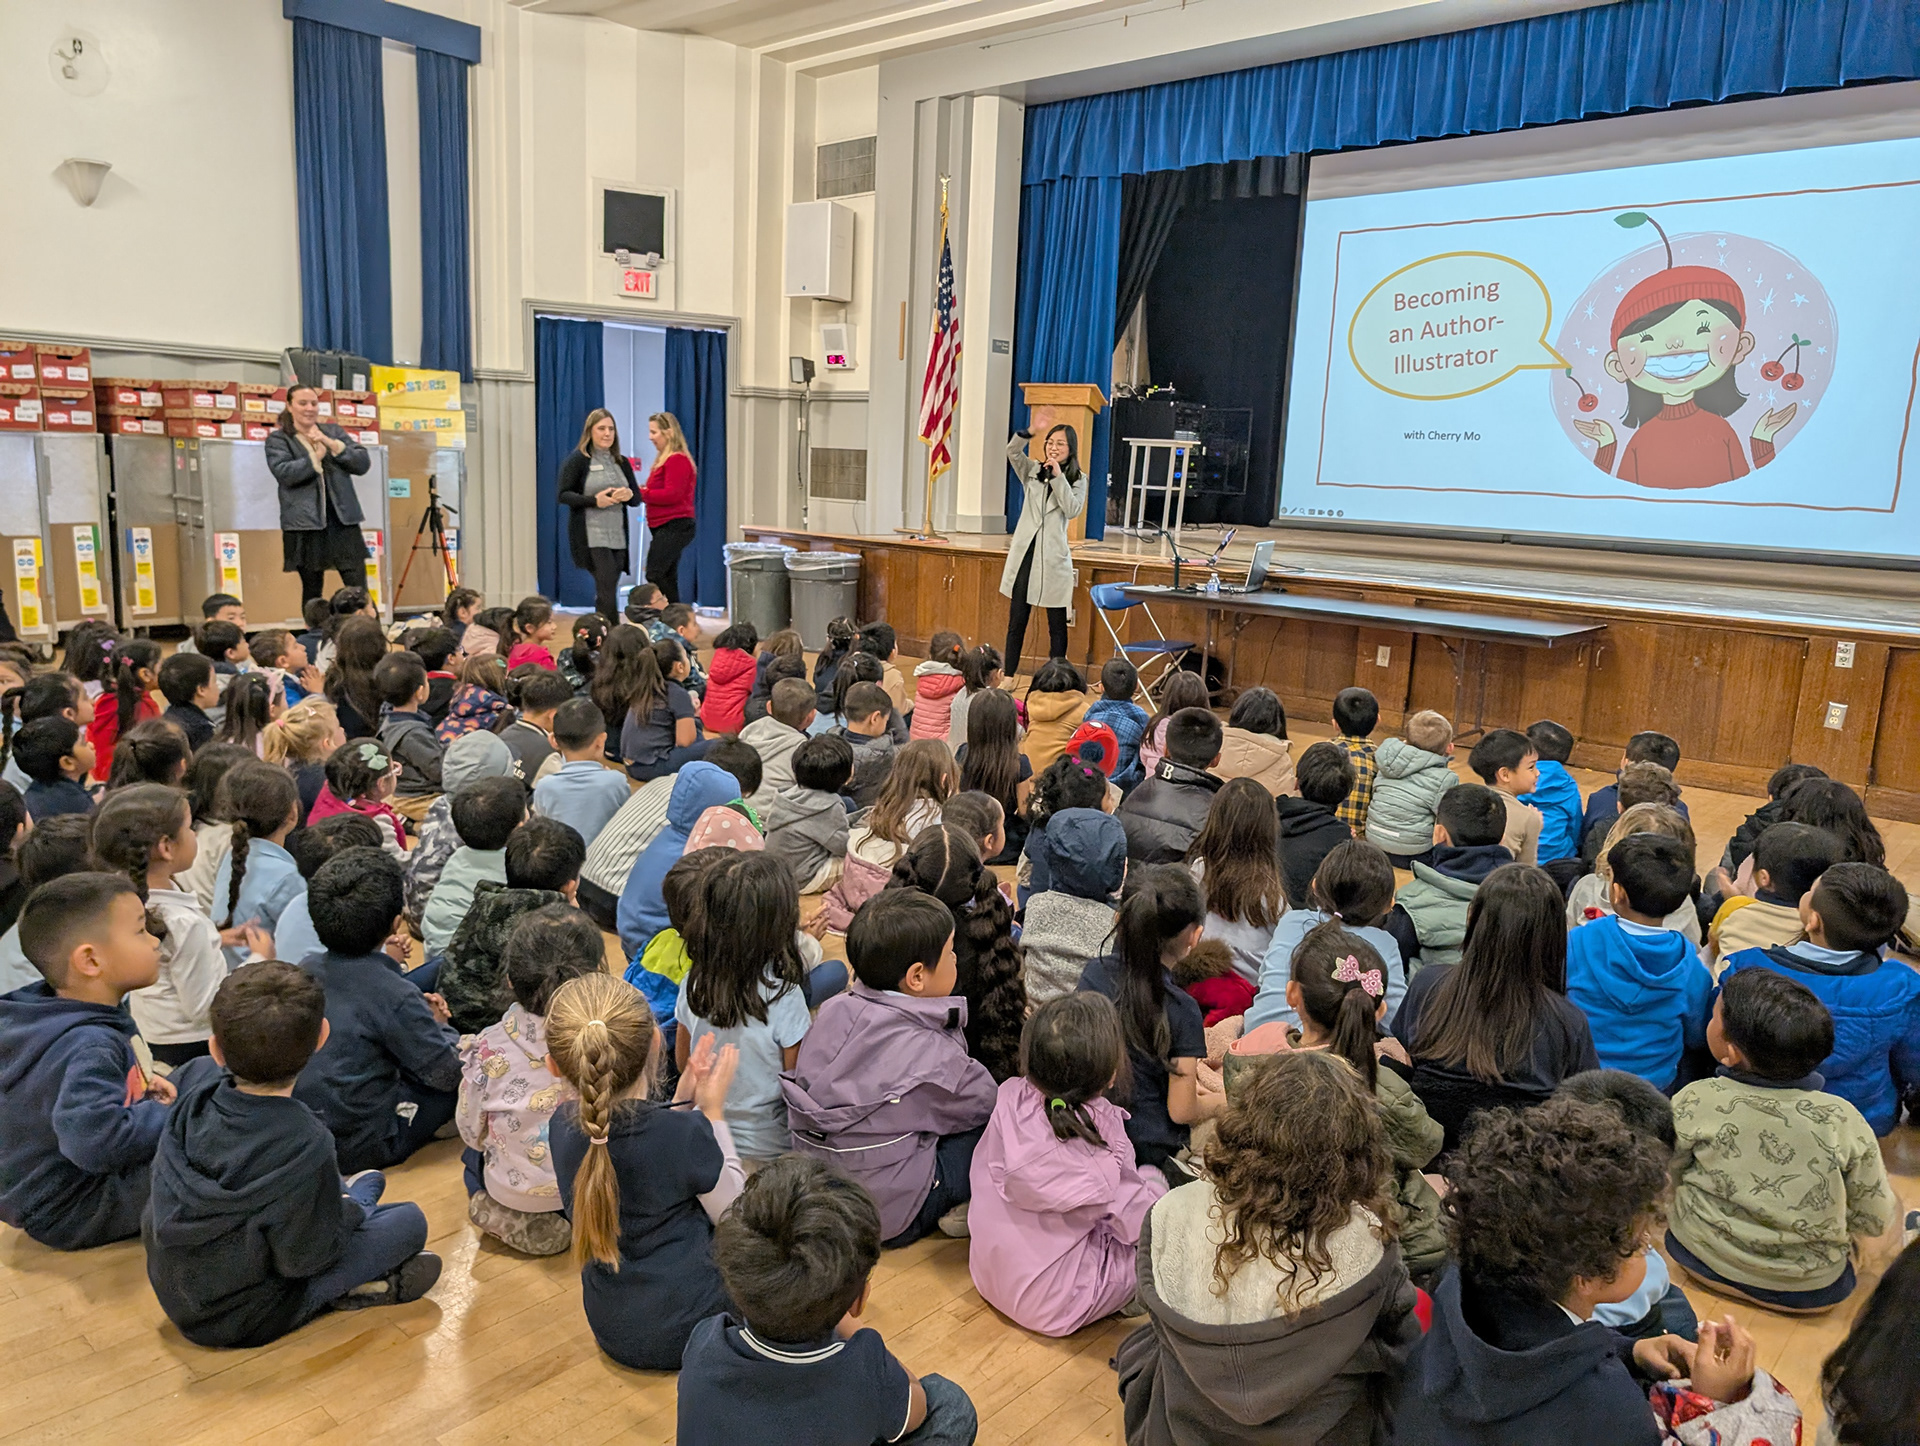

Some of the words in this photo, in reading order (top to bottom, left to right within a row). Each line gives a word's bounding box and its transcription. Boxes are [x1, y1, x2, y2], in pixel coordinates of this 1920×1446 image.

[624, 271, 651, 293] EXIT
[1394, 282, 1500, 311] Becoming
[1389, 327, 1413, 343] an
[1420, 315, 1504, 340] Author-
[1394, 348, 1499, 374] Illustrator
[387, 380, 446, 393] POSTERS
[394, 418, 452, 431] POSTERS
[1403, 430, 1425, 441] with
[1428, 430, 1461, 442] Cherry
[1463, 431, 1481, 441] Mo
[513, 768, 526, 779] LES
[1161, 763, 1174, 780] B
